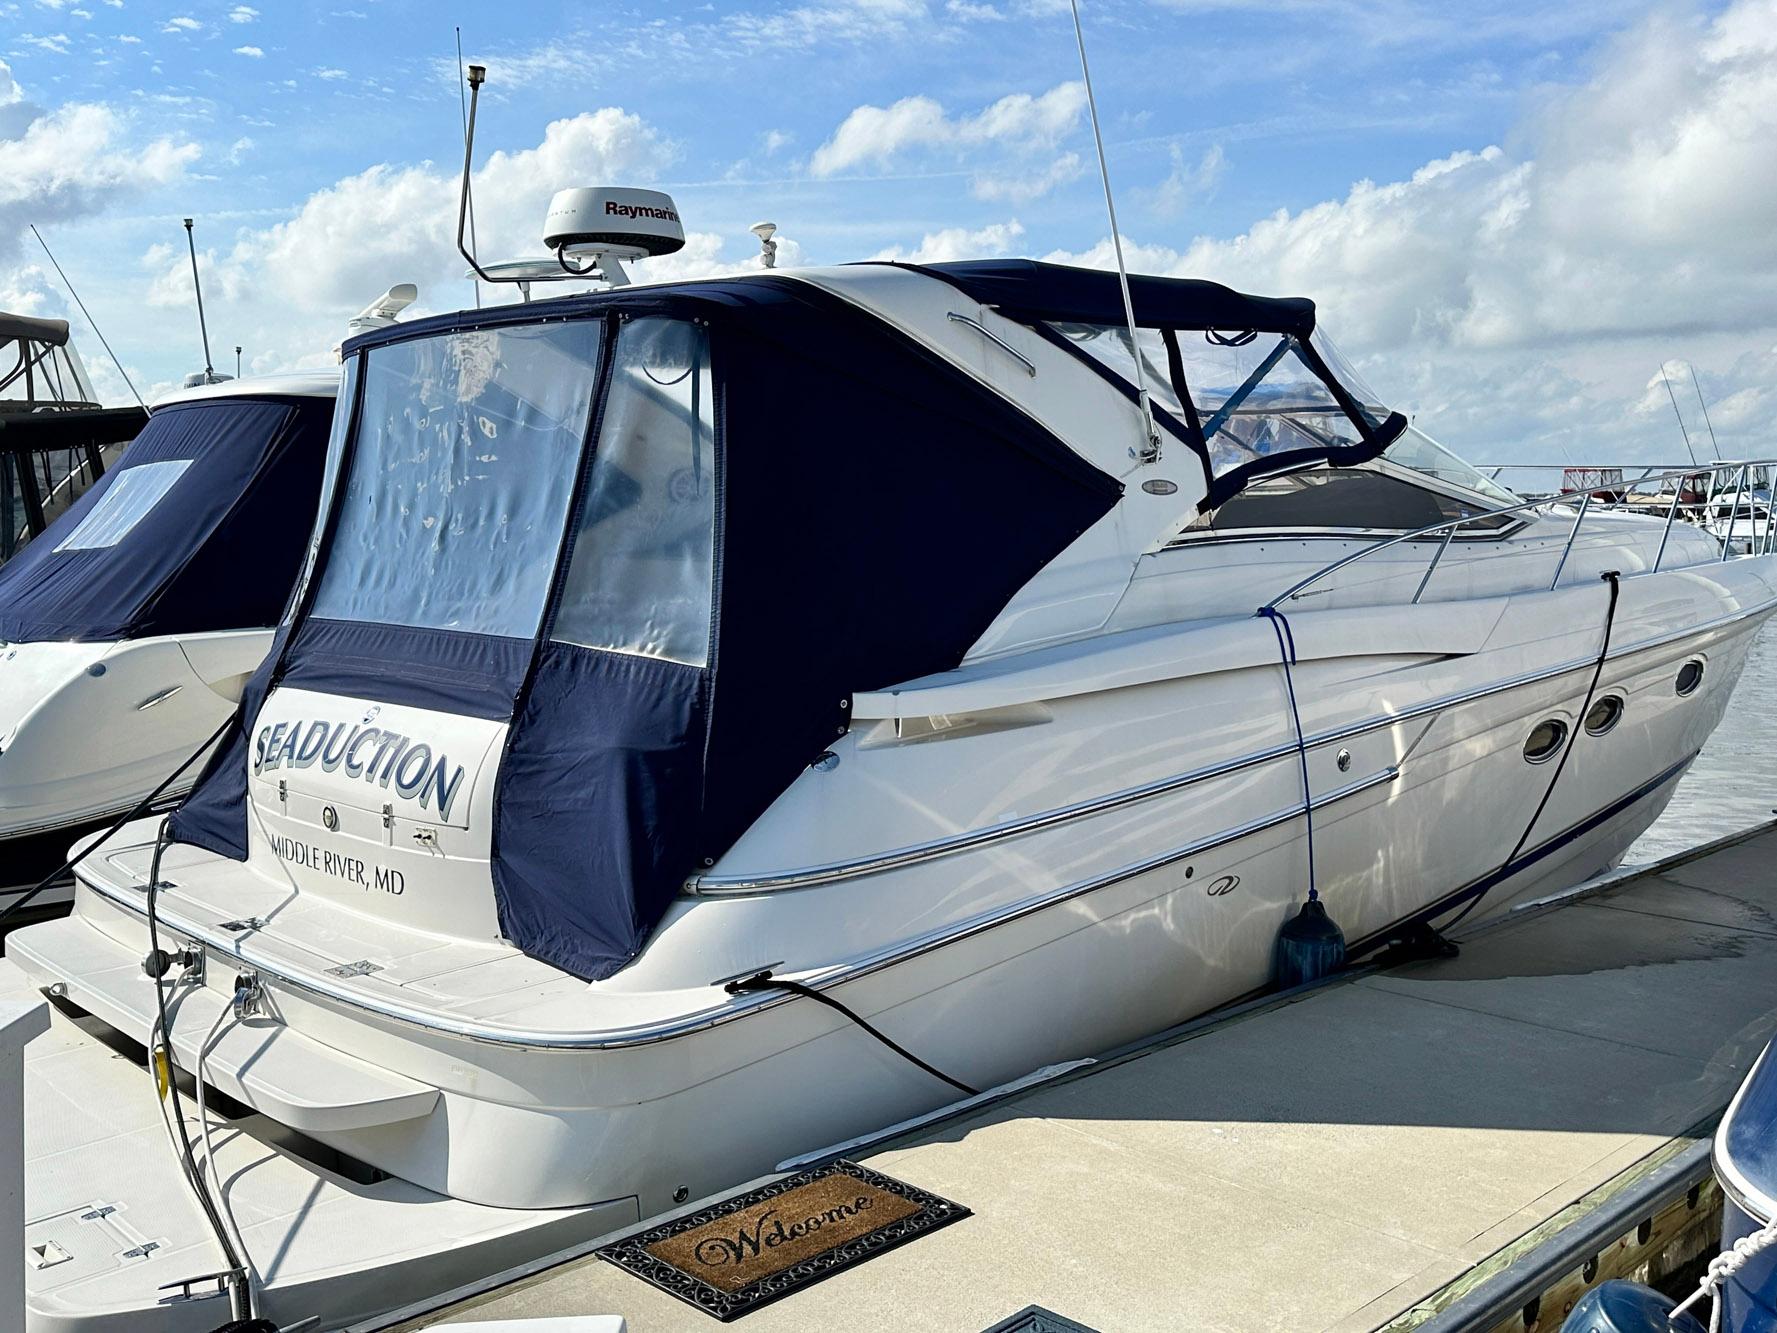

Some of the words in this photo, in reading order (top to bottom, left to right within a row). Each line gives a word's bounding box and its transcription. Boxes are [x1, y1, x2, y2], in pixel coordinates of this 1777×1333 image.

[254, 720, 465, 823] SEADUCTION
[271, 833, 320, 871] MIDDLE
[324, 850, 371, 892] RIVER,
[374, 866, 405, 896] MD
[694, 1195, 874, 1267] Welcome
